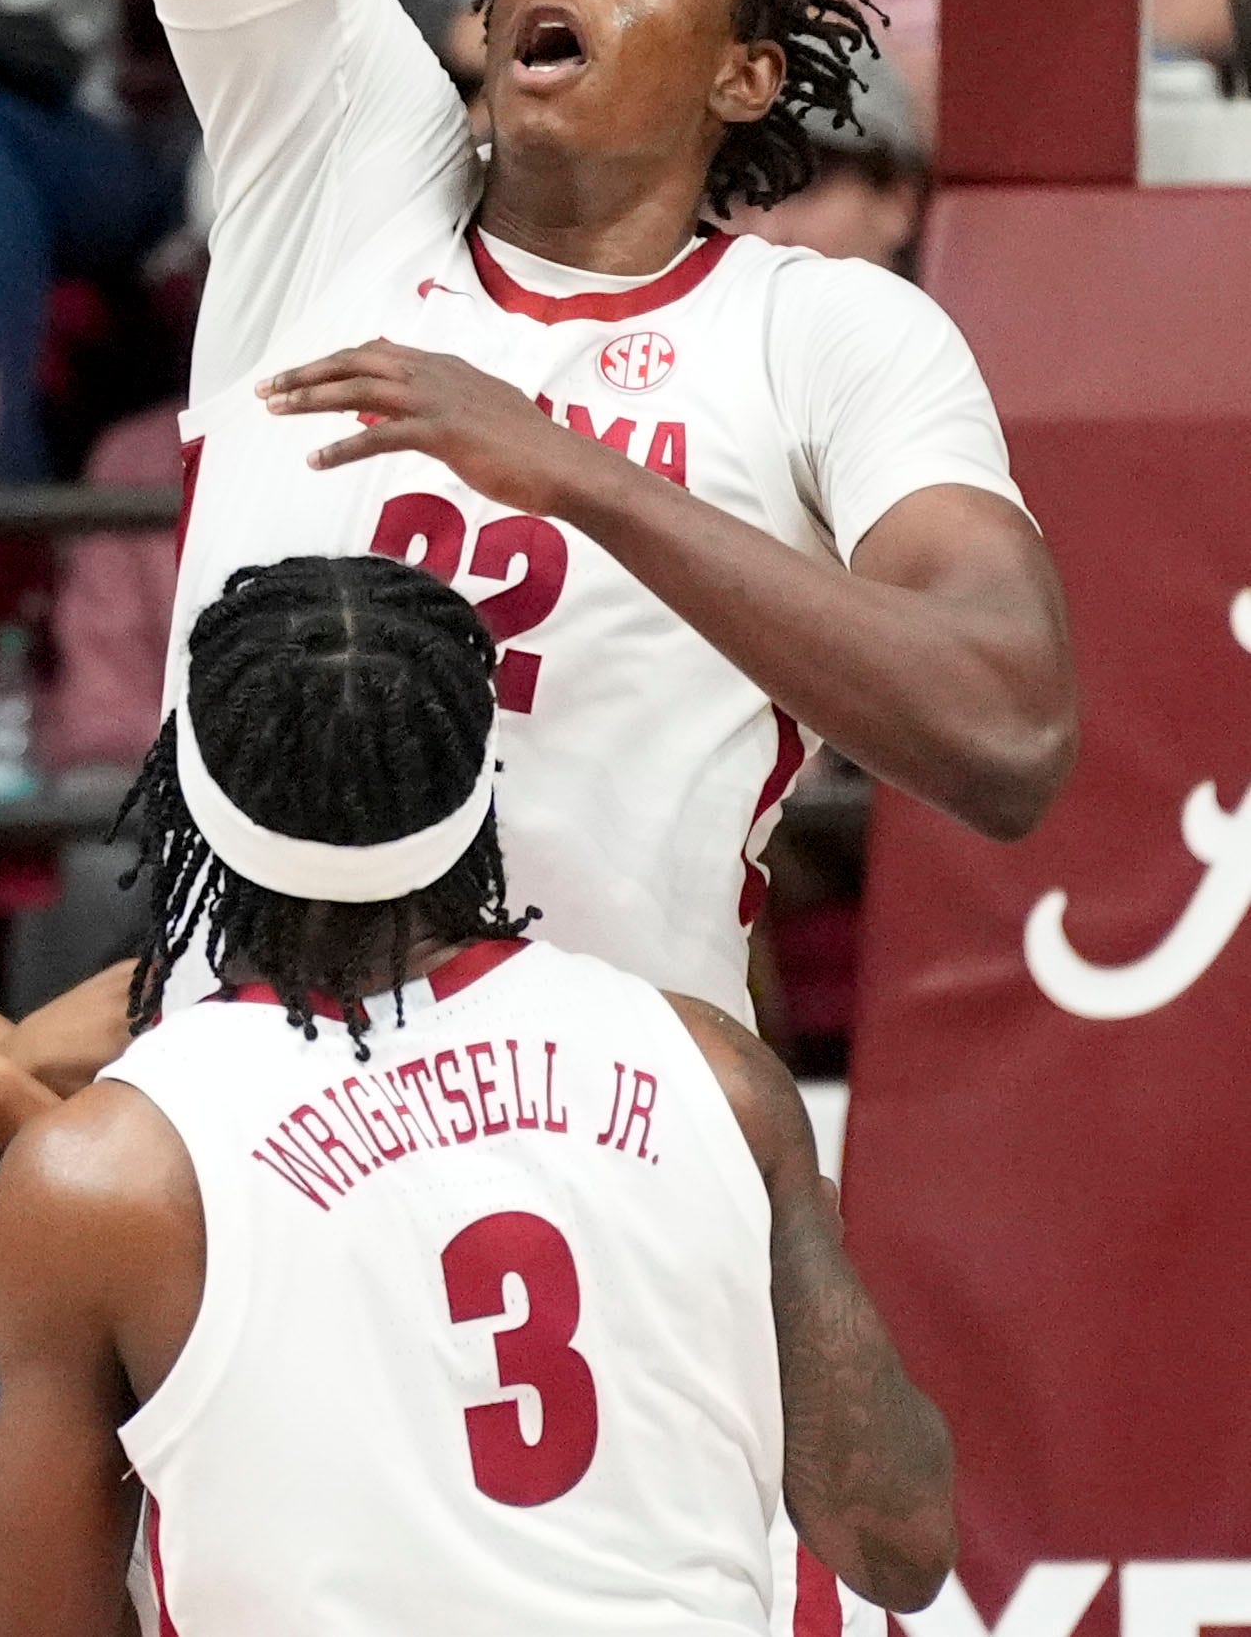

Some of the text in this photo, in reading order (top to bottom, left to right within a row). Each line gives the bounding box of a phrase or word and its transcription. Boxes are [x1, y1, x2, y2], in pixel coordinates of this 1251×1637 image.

[601, 332, 675, 390] SEC
[251, 1039, 660, 1212] WRIGHTSELL JR.
[440, 1210, 598, 1508] 3
